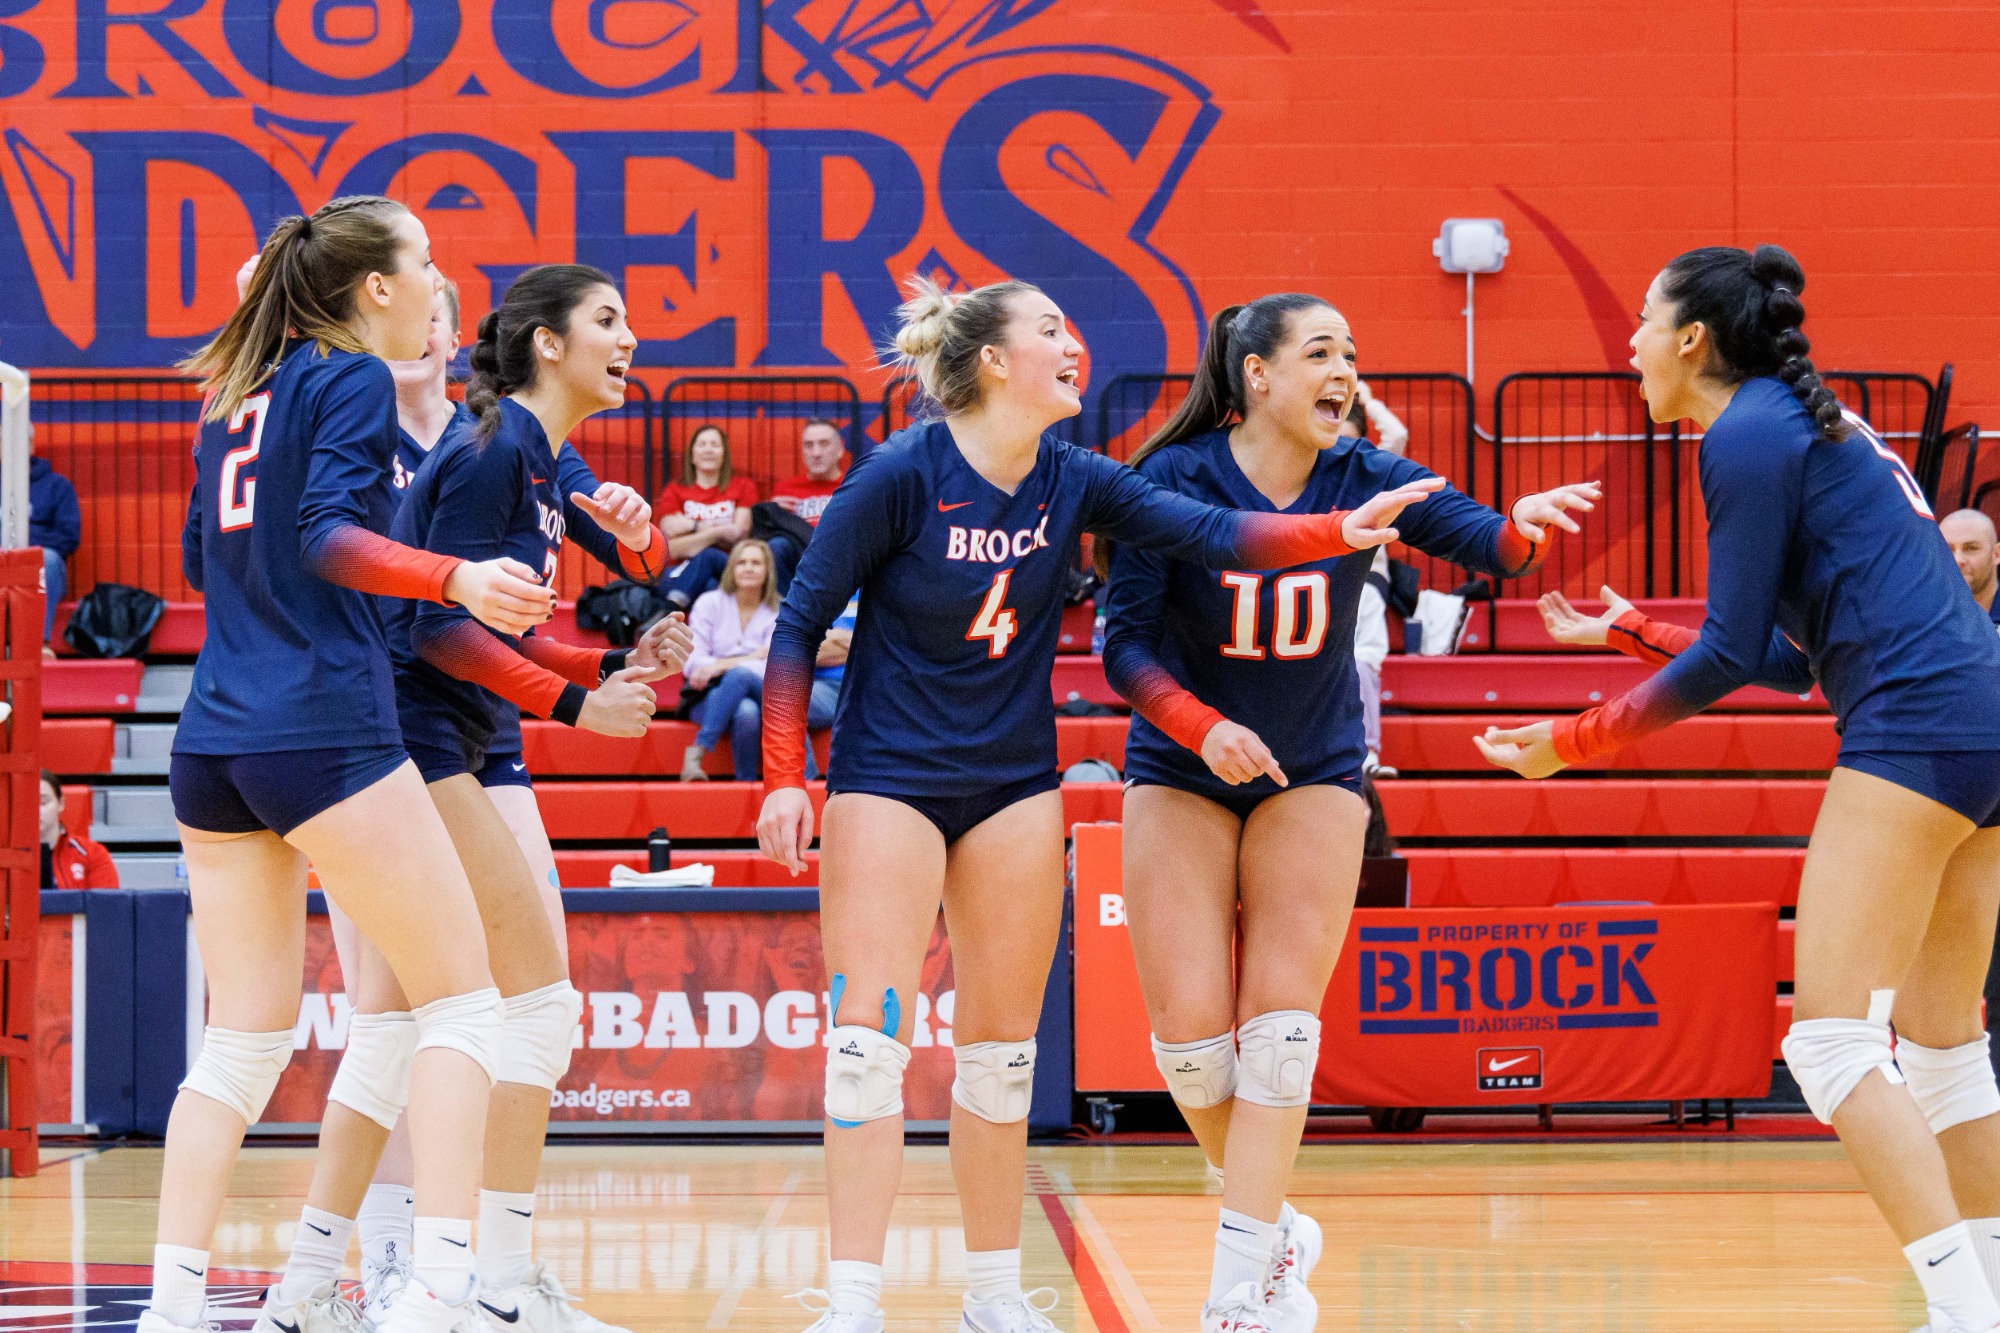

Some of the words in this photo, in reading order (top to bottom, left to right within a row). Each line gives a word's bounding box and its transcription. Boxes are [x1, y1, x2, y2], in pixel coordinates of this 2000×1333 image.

[217, 389, 272, 534] 2
[541, 547, 558, 588] 7
[964, 568, 1019, 659] 4
[1219, 570, 1330, 661] 10
[1099, 892, 1129, 927] B
[1426, 924, 1549, 942] PROPERTY
[1558, 922, 1588, 939] OF
[1359, 942, 1658, 1012] BROCK
[1462, 1014, 1555, 1034] BADGERS
[1486, 1076, 1535, 1087] TEAM
